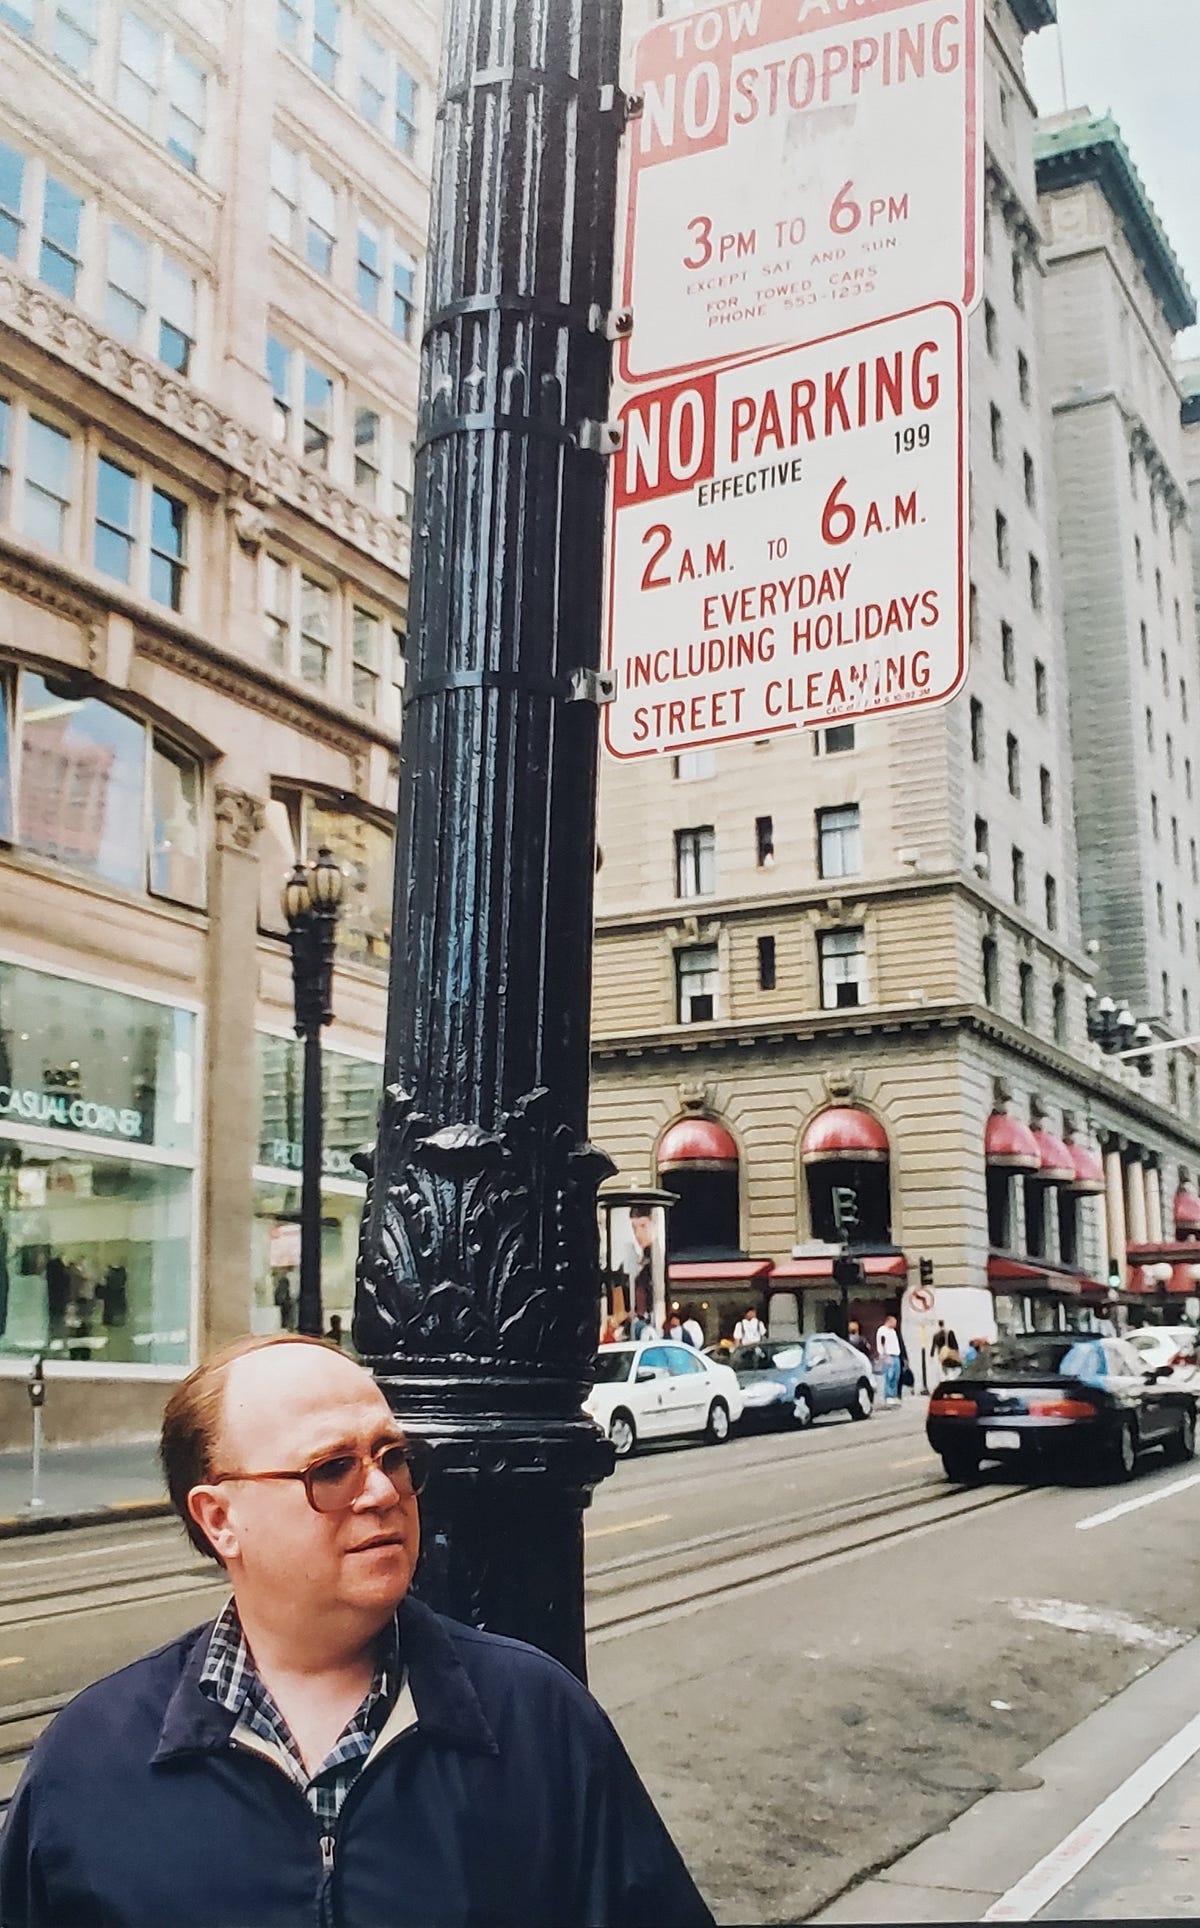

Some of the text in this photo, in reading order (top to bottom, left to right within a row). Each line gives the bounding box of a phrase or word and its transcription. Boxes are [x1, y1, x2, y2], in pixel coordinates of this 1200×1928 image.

[669, 0, 762, 58] TOW
[640, 14, 961, 154] NO STOPPING
[776, 217, 806, 248] TO
[685, 236, 897, 296] EXCEPT SAT AND SUN
[706, 264, 879, 313] FOR TOWED CARS
[707, 304, 768, 328] PHONE
[625, 340, 940, 495] NO PARKING
[697, 423, 931, 507] EFFECTIVE 199
[766, 537, 788, 562] TO
[703, 563, 852, 632] EVERYDAY
[625, 590, 939, 690] INCLUDING HOLIDAYS
[632, 687, 746, 742] STREET
[0, 1085, 143, 1137] CASUAL CORNER
